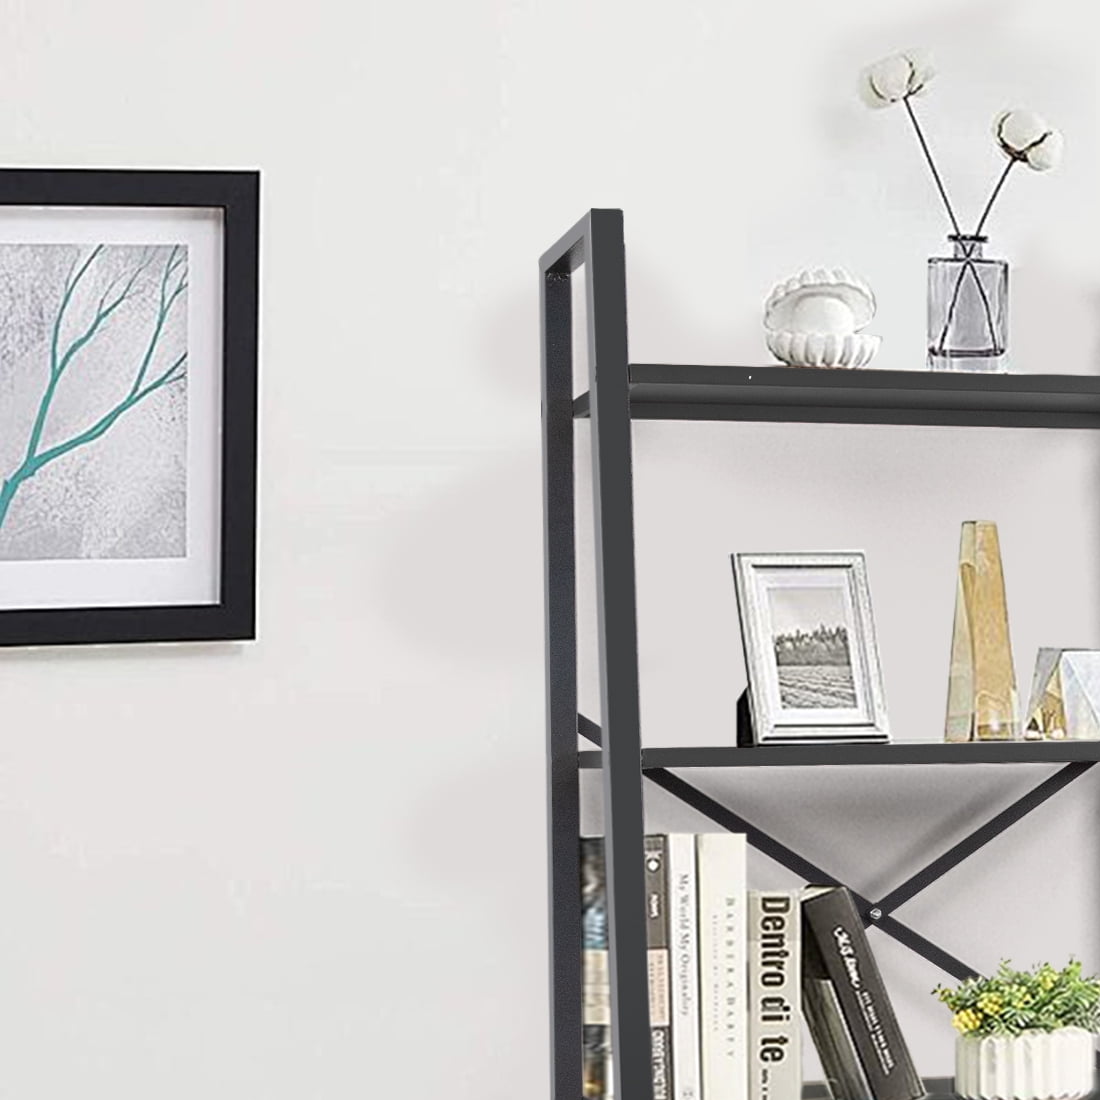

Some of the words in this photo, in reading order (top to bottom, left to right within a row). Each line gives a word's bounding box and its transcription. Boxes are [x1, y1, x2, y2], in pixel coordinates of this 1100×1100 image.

[678, 873, 690, 891] My
[679, 894, 690, 930] World
[679, 933, 690, 951] My
[761, 897, 791, 987] Dentro
[761, 997, 791, 1022] di
[760, 1036, 789, 1063] te
